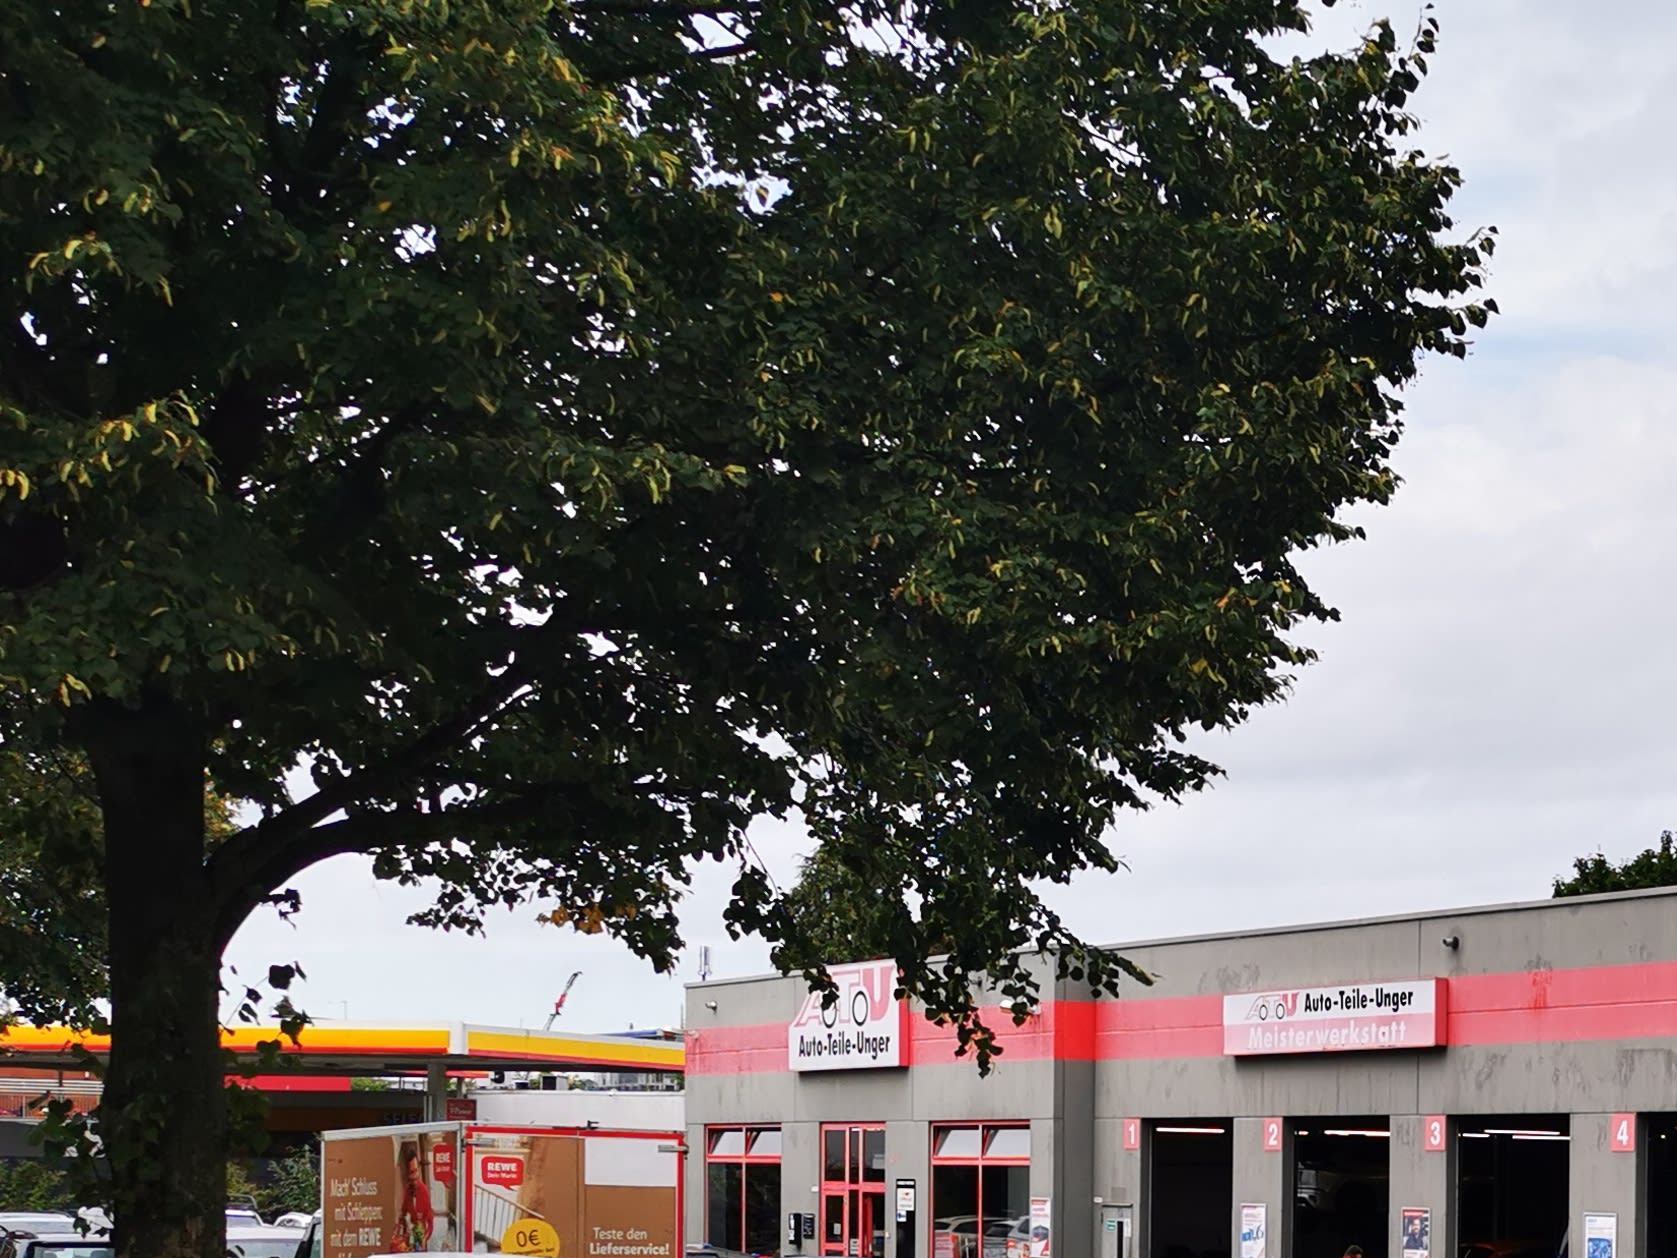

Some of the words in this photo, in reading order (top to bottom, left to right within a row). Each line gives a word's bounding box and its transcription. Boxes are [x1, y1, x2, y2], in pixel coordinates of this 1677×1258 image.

[1304, 988, 1414, 1013] Auto-Teile-Unger
[1249, 1020, 1406, 1049] Meisterwerkstatt
[799, 1031, 890, 1060] Auto-Teile-Unger
[1128, 1123, 1135, 1145] 1
[1268, 1123, 1278, 1146] 2
[1430, 1121, 1441, 1146] 3
[1616, 1120, 1629, 1145] 4
[487, 1162, 518, 1172] REWE
[352, 1177, 378, 1196] Schluss
[335, 1202, 346, 1221] mit
[330, 1229, 342, 1247] mit
[343, 1228, 357, 1247] dem
[359, 1227, 381, 1247] REWE
[516, 1229, 541, 1247] 0€
[593, 1226, 624, 1240] Teste
[626, 1227, 648, 1240] den
[590, 1242, 670, 1255] Lieferservice!
